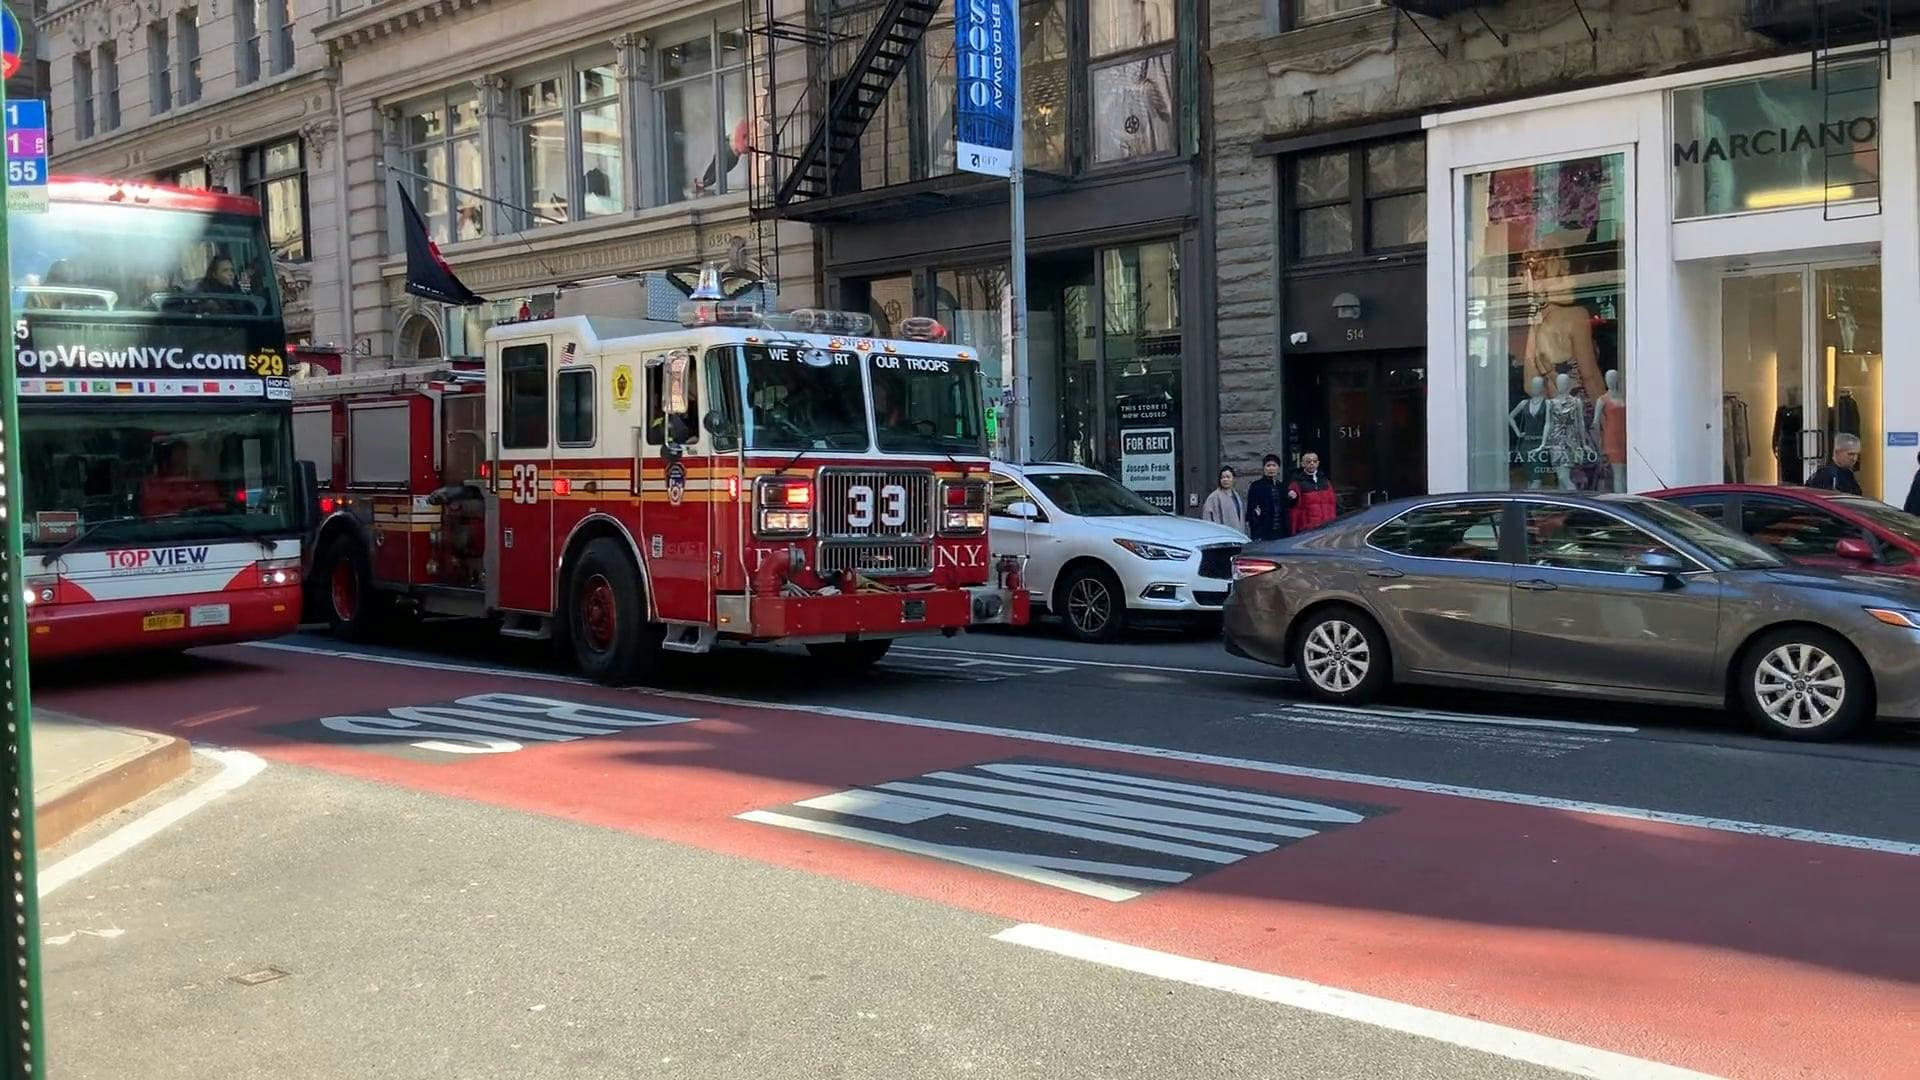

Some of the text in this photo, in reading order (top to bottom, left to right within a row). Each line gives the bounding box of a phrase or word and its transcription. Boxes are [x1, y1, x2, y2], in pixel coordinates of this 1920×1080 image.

[991, 3, 1003, 109] BROADWAY
[7, 105, 19, 125] 1
[1673, 116, 1878, 167] MARCIANO
[9, 161, 37, 182] 55
[1346, 328, 1365, 341] 514
[15, 344, 247, 373] opViewNYC.com
[248, 354, 284, 376] $29
[767, 348, 790, 362] WE
[875, 355, 900, 370] OUR
[905, 357, 950, 374] TROOPS
[1138, 403, 1159, 411] STORE
[1140, 411, 1167, 419] CLOSED
[1126, 436, 1170, 451] FOR RENT
[1338, 427, 1361, 438] 514
[512, 463, 538, 504] 33
[848, 485, 906, 528] 33
[937, 545, 985, 568] N.Y.
[320, 693, 701, 754] BUS
[733, 763, 1366, 903] ONLY
